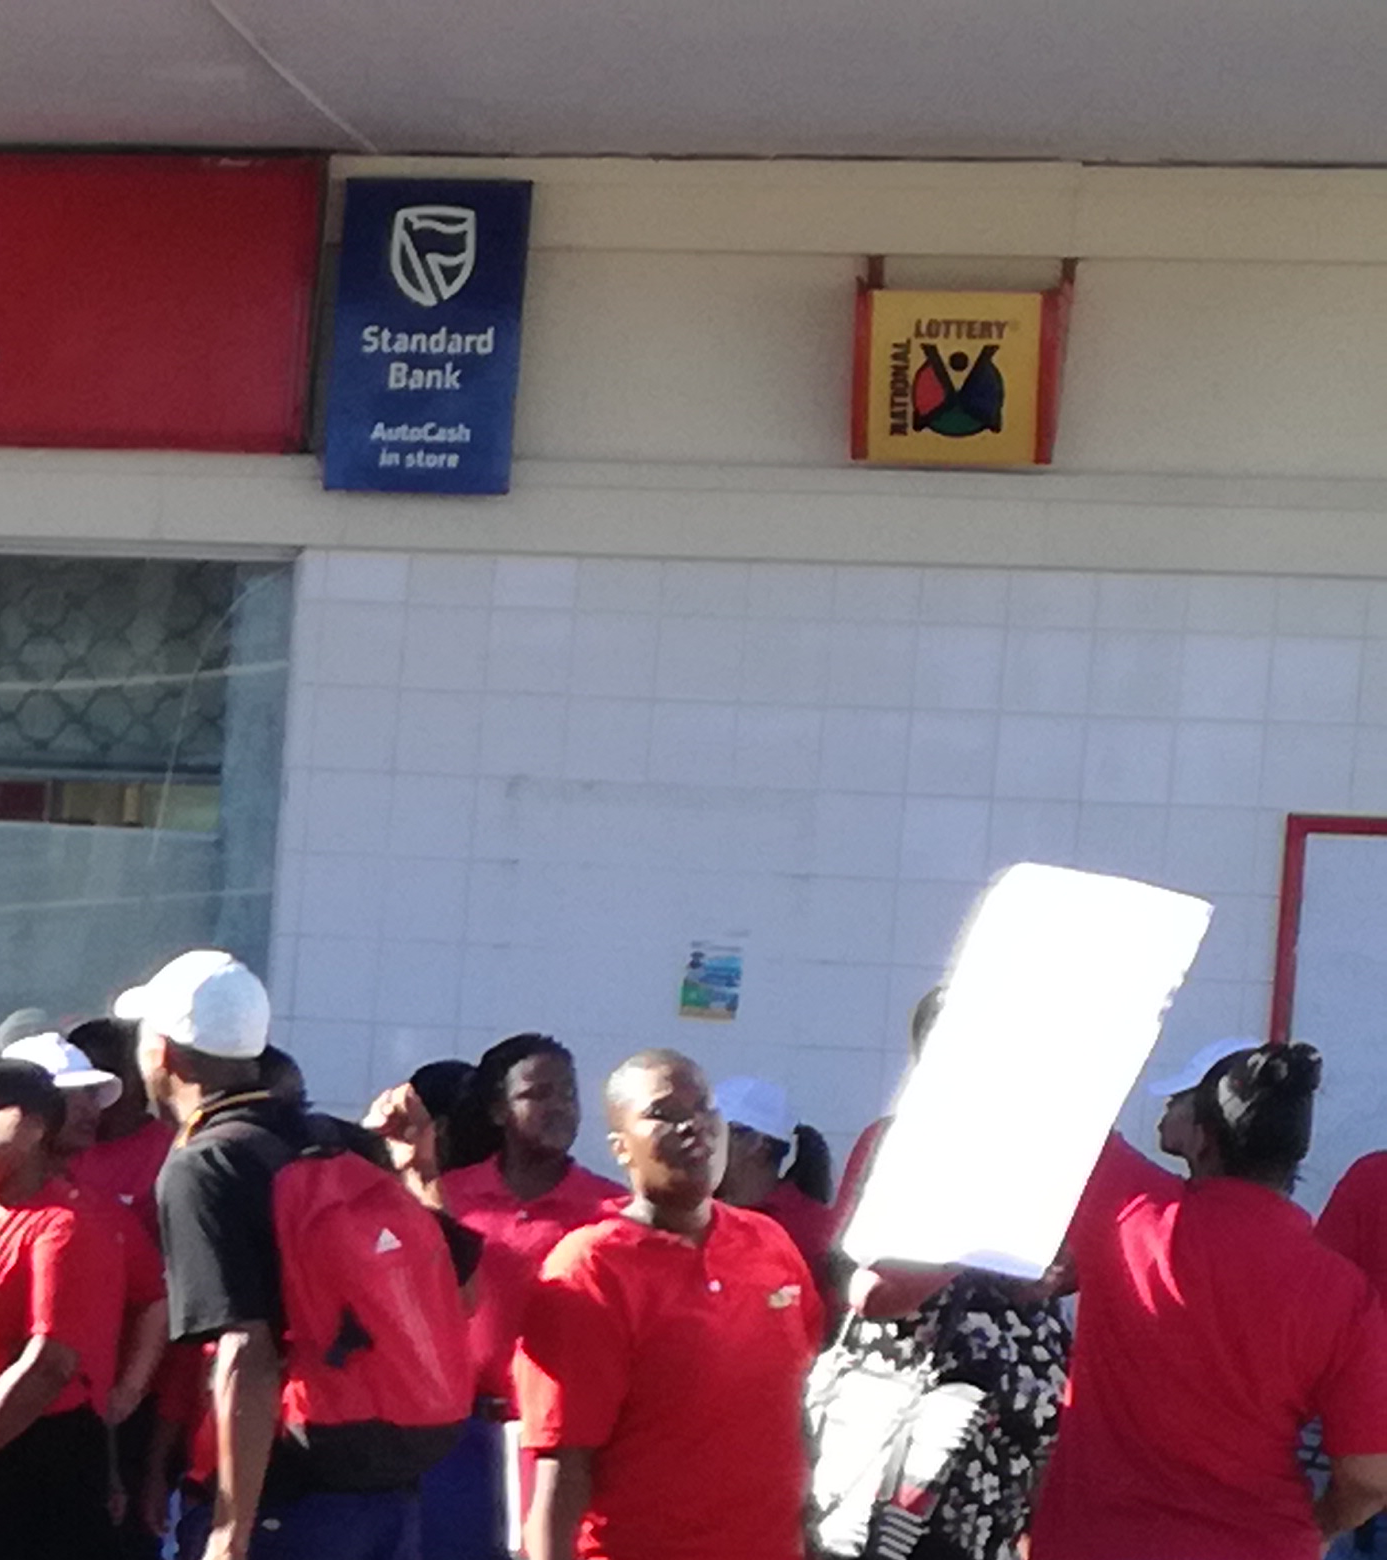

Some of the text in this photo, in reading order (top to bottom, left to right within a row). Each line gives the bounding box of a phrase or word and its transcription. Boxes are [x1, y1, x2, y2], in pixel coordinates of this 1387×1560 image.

[361, 324, 495, 355] Standard
[914, 318, 1008, 340] LOTTERY
[387, 361, 462, 390] Bank
[889, 338, 911, 437] NATIONAL
[370, 421, 471, 443] AutoCash
[379, 447, 460, 468] in store
